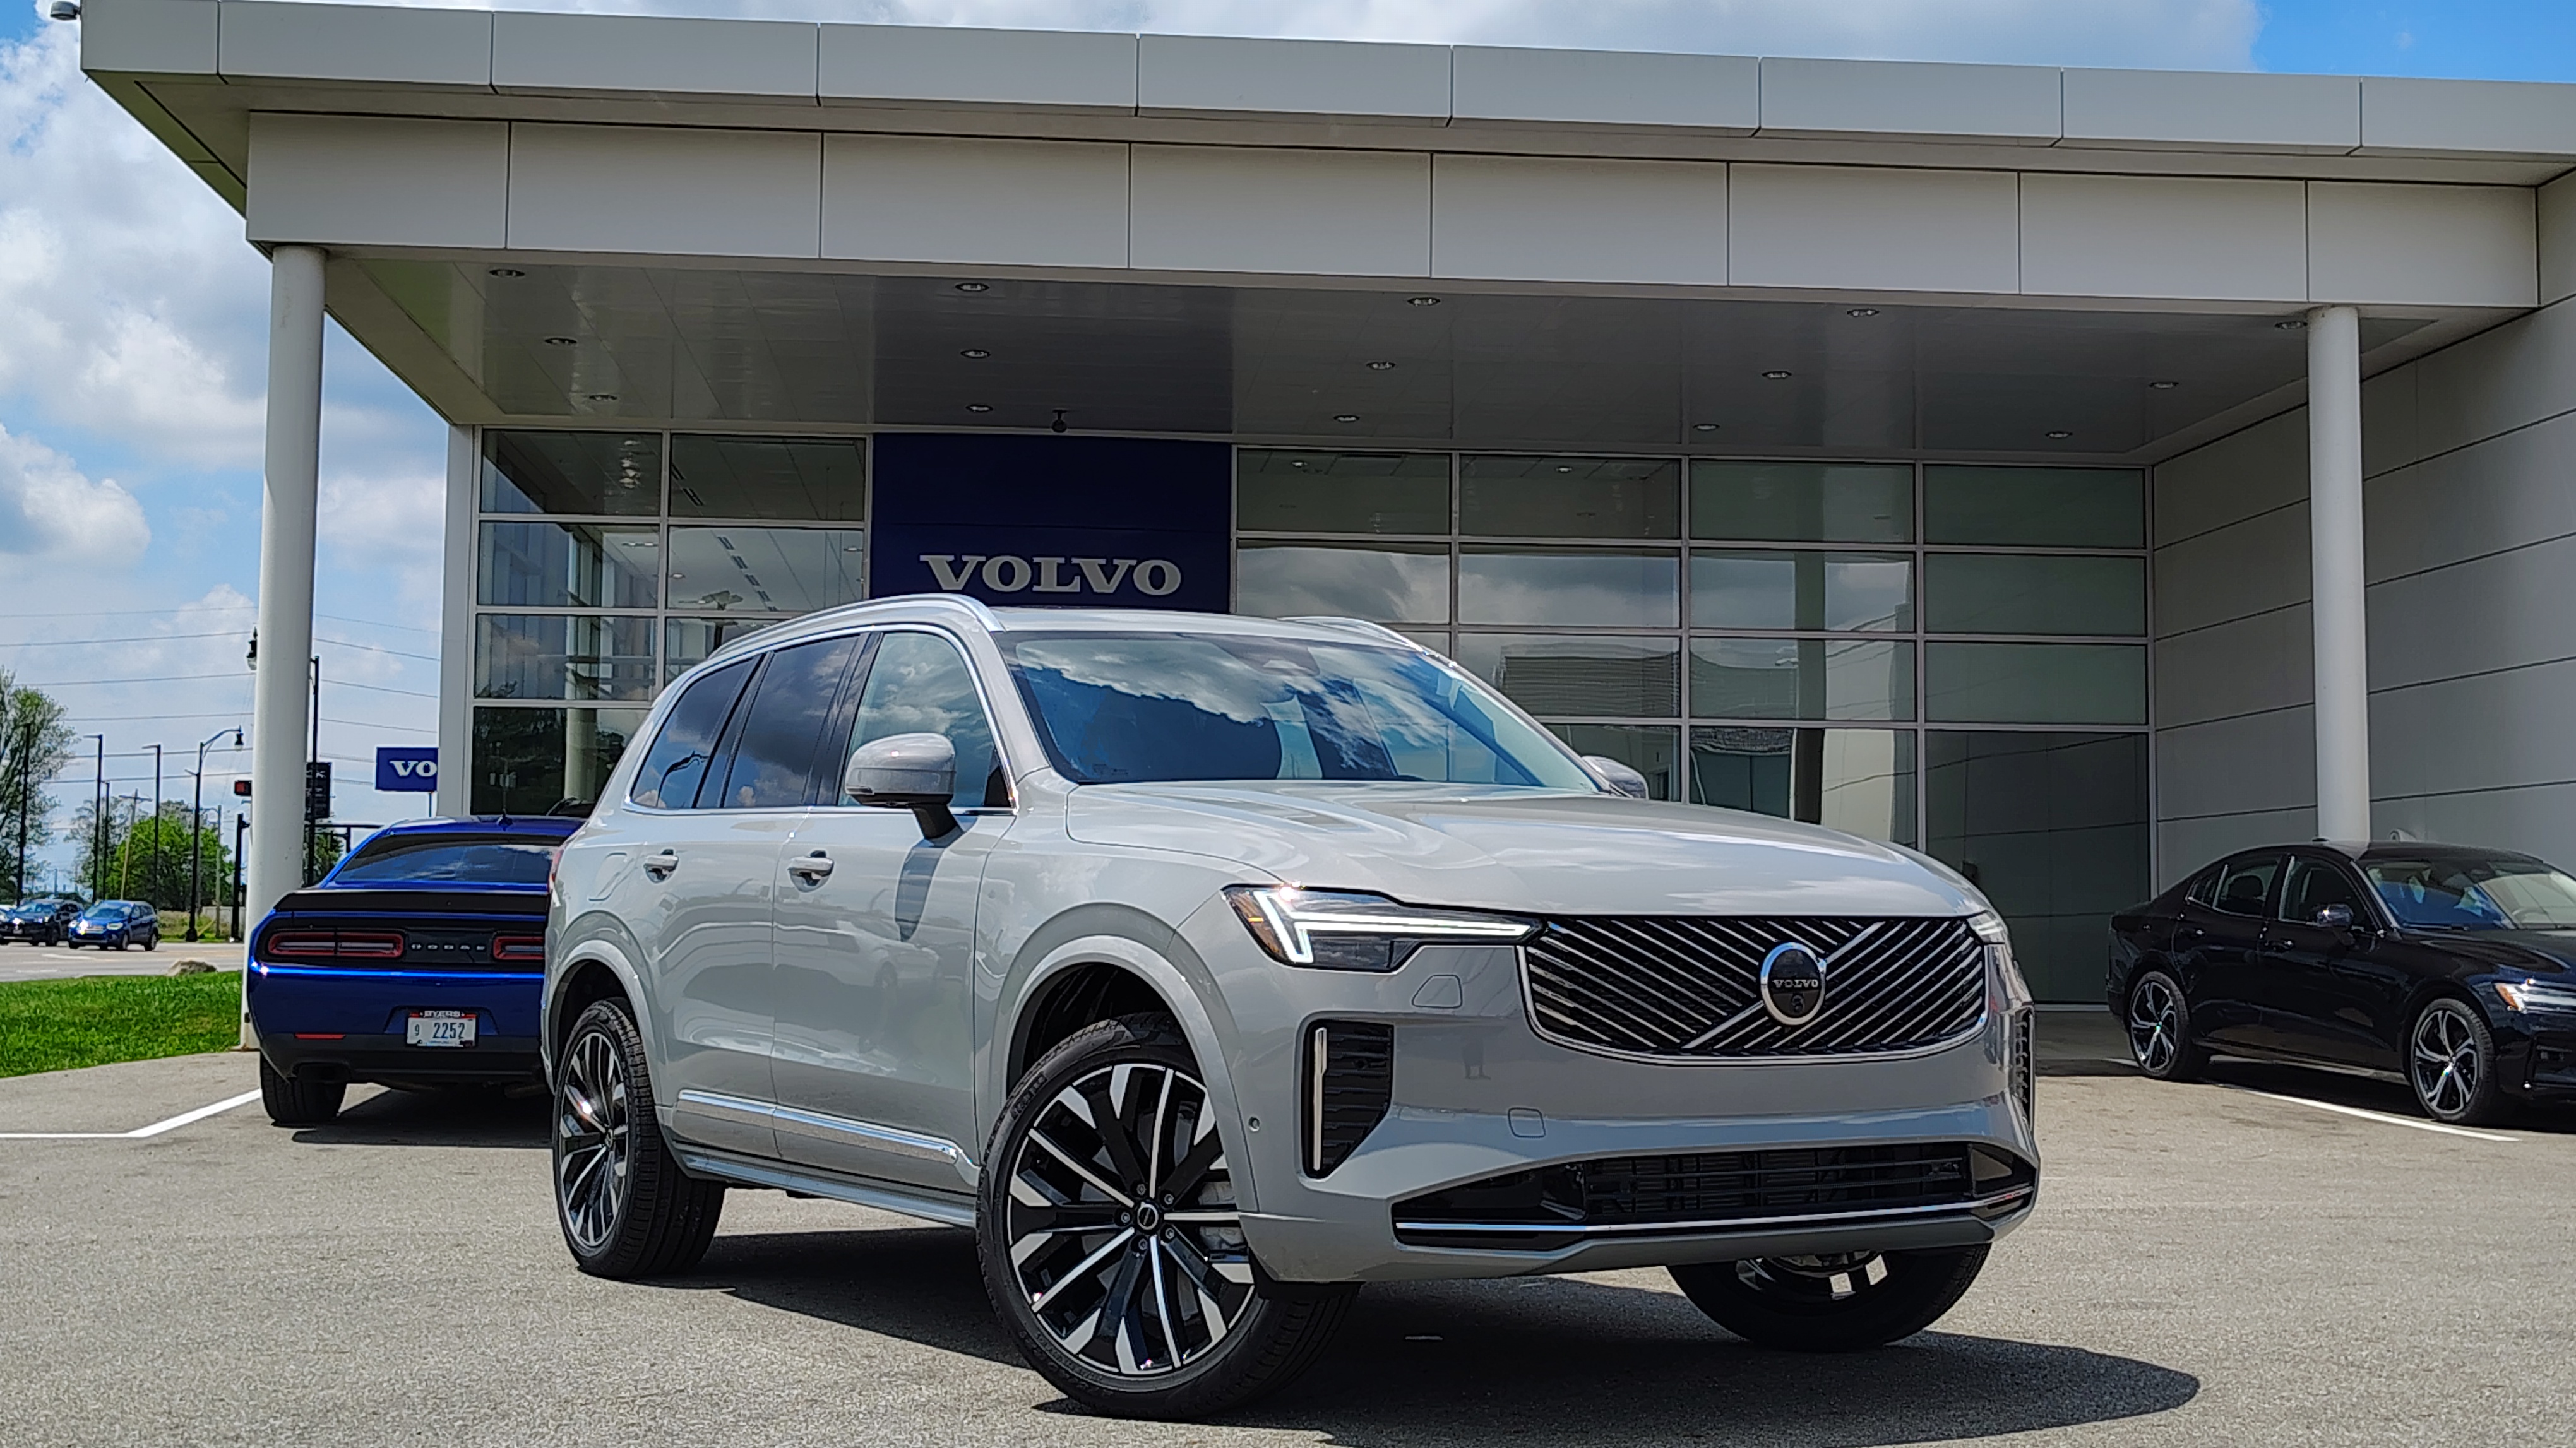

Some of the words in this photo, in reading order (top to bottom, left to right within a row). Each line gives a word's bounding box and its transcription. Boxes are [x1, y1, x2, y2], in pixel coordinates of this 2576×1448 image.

[919, 555, 1181, 595] VOLVO
[1772, 979, 1819, 988] VOLVO
[432, 1022, 465, 1040] 2252
